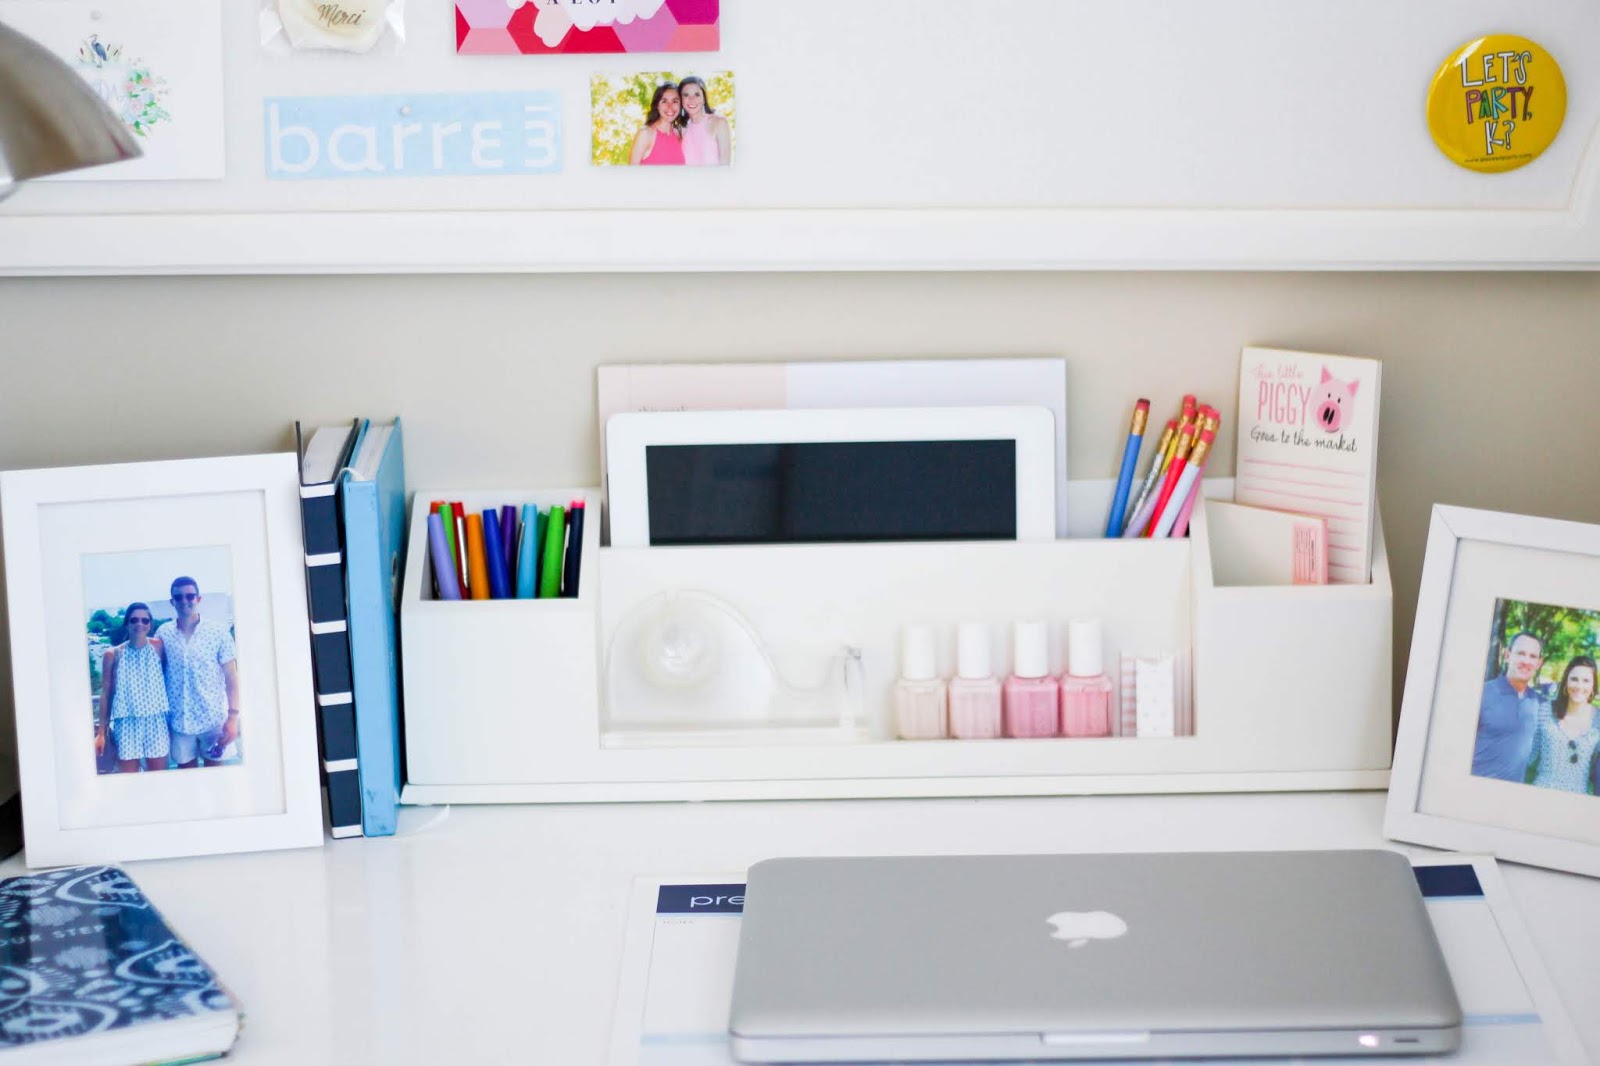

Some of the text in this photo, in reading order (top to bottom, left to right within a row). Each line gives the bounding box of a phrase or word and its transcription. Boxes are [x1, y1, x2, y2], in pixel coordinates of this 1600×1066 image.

[317, 4, 367, 27] Merci
[1460, 50, 1532, 88] LET'S
[1484, 120, 1516, 155] K?
[1257, 380, 1312, 426] PIGGY
[1281, 430, 1291, 444] to
[1293, 429, 1312, 447] the
[1315, 434, 1358, 453] market
